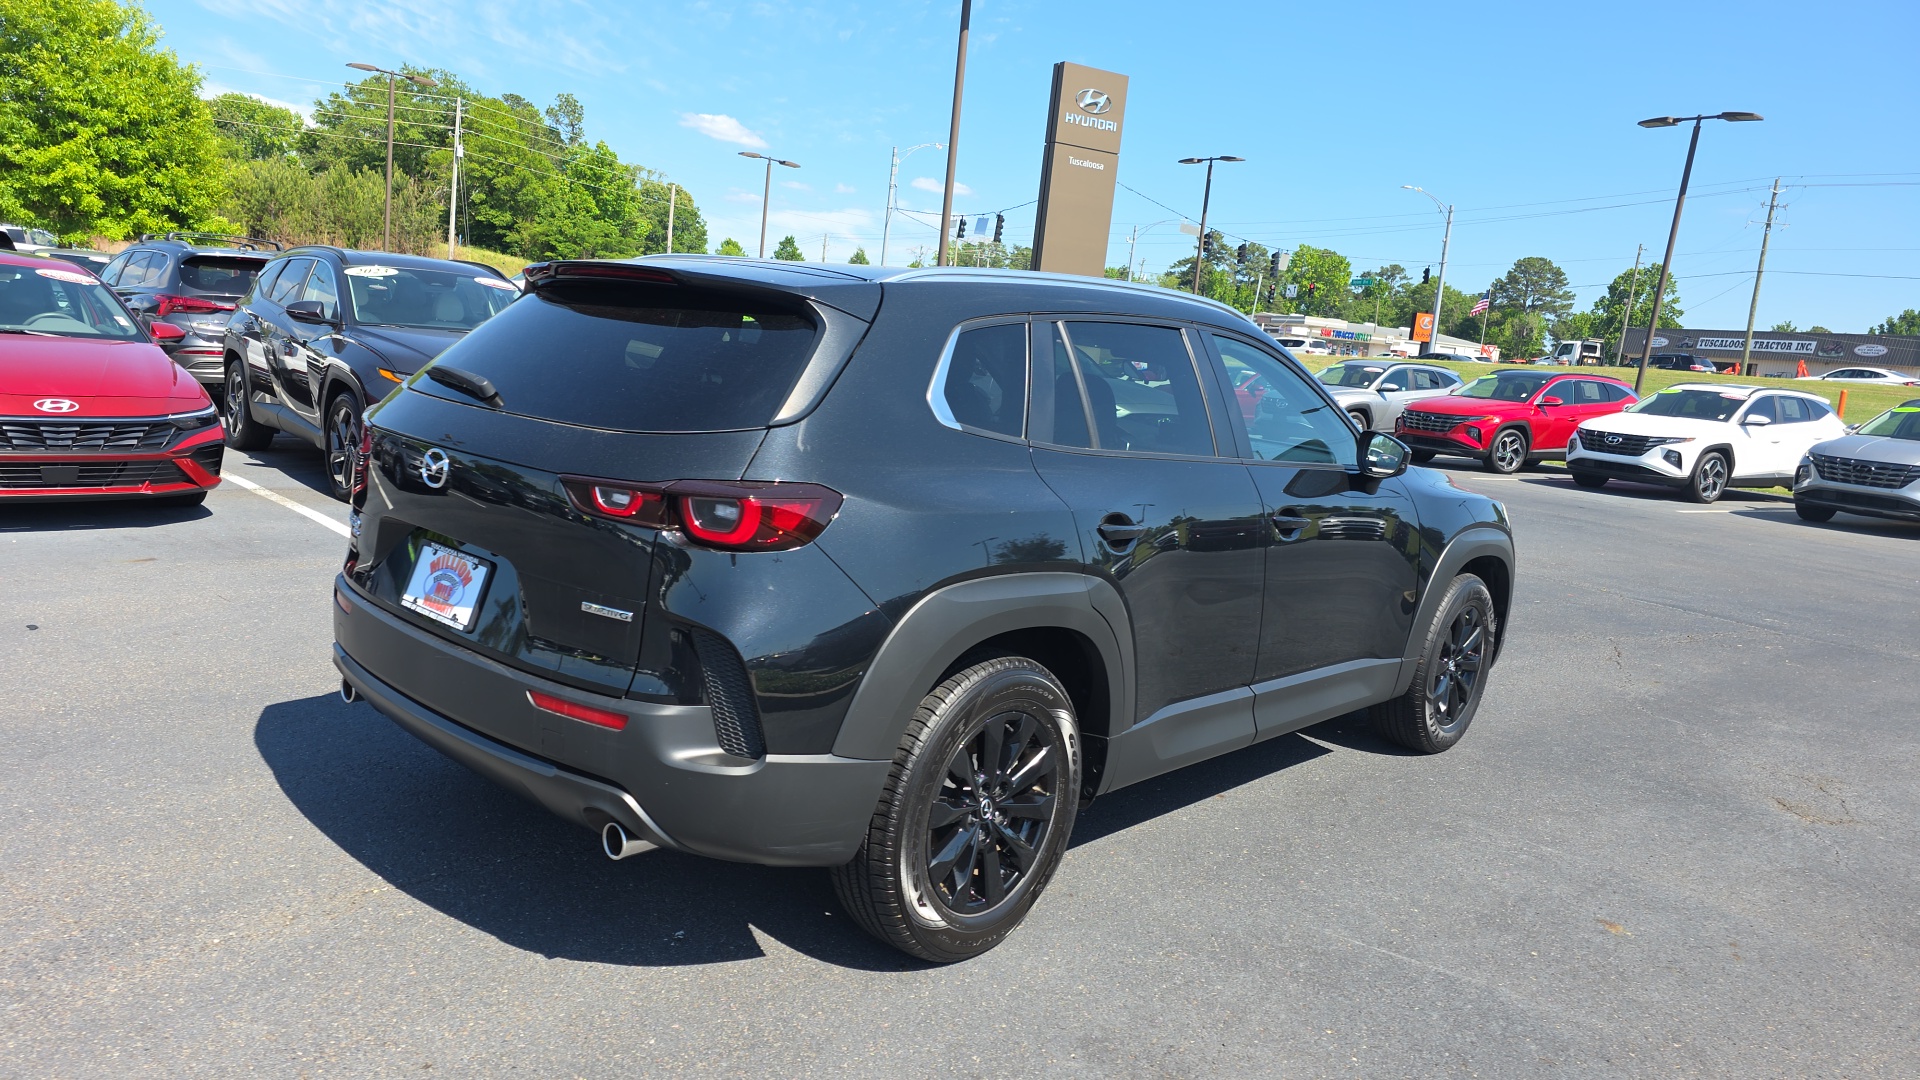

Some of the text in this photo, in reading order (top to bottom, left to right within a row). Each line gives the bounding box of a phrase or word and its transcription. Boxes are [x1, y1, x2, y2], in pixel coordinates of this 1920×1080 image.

[1065, 112, 1117, 132] HYUNDAI
[1069, 156, 1104, 170] Tuscaloosa
[1415, 331, 1431, 339] Kubot
[1699, 338, 1813, 352] TUSCALOOS TRACTOR INC.
[430, 554, 473, 587] MILLION
[433, 582, 453, 601] MILE
